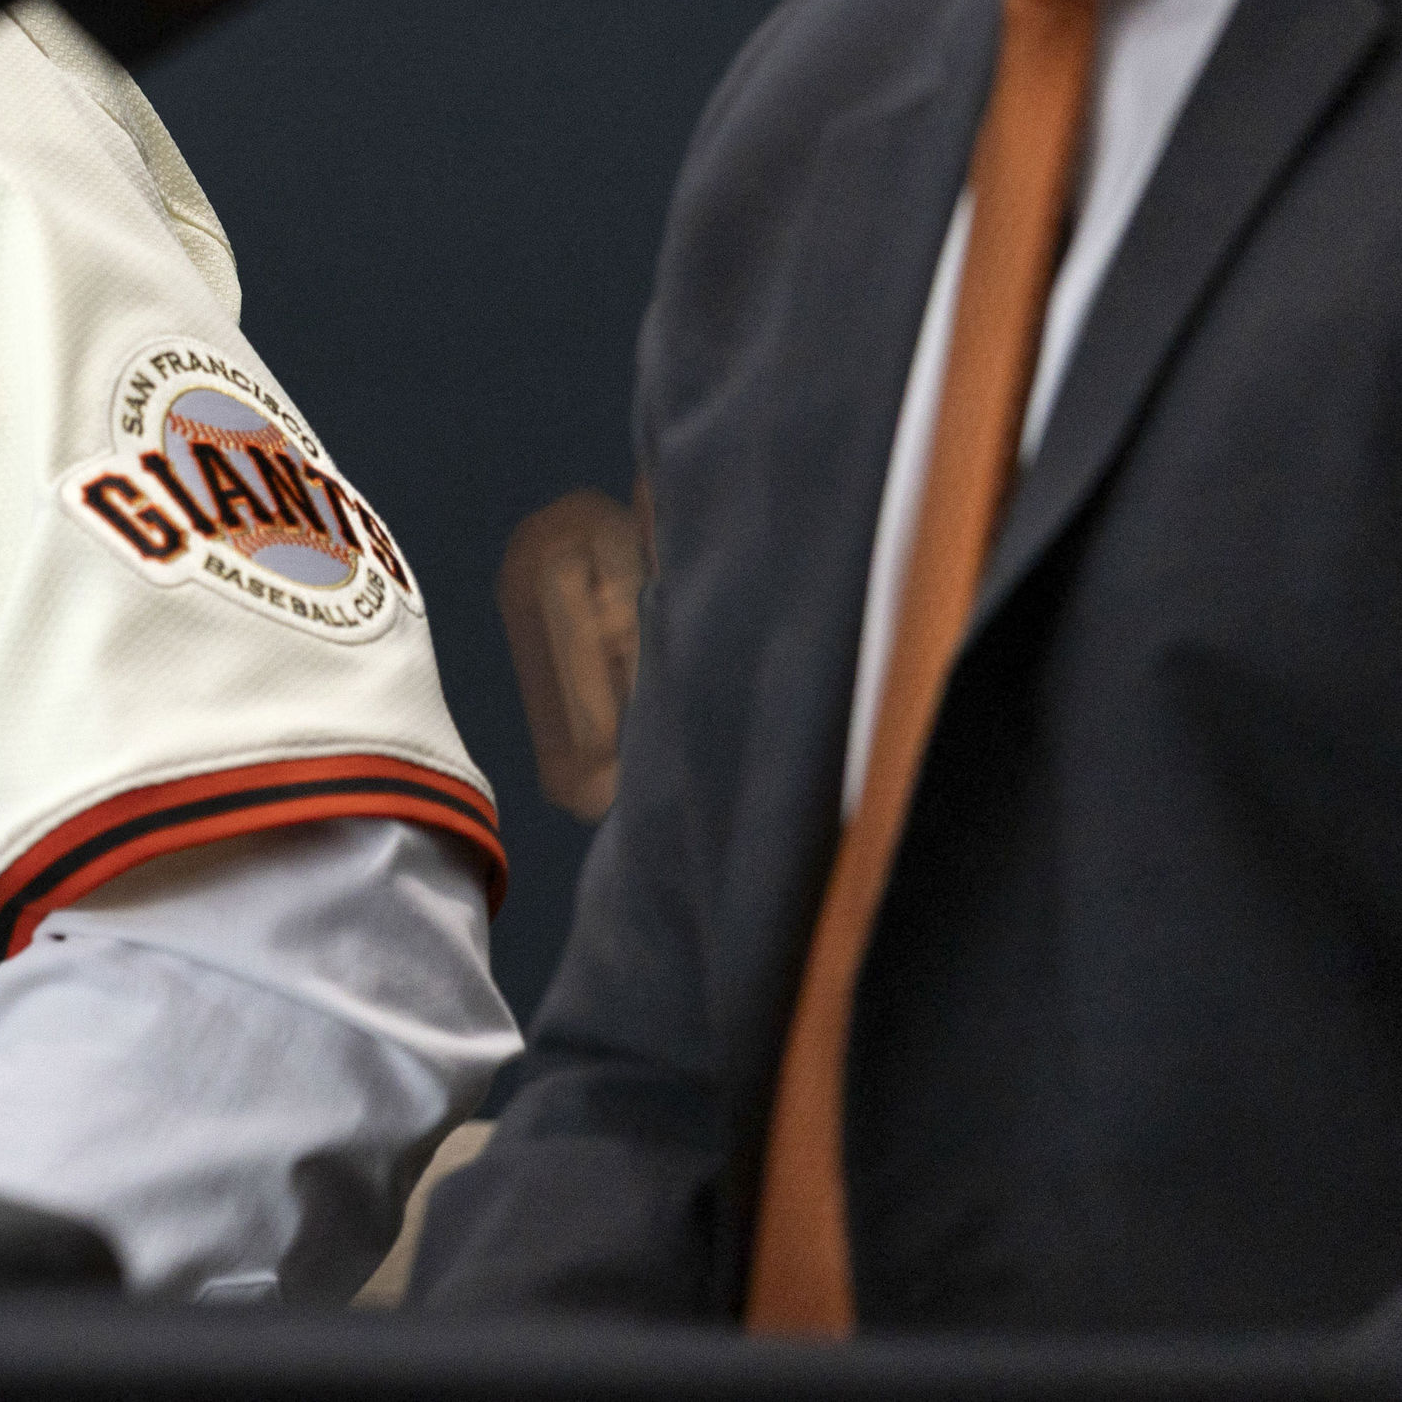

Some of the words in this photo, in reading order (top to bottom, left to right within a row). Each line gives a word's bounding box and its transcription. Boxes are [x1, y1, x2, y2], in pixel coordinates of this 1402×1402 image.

[121, 370, 156, 437] SAN
[149, 350, 319, 459] FRANCISCO
[81, 437, 413, 594] GIANTS
[203, 553, 360, 628] BASEBALL
[354, 567, 386, 619] CLUB
